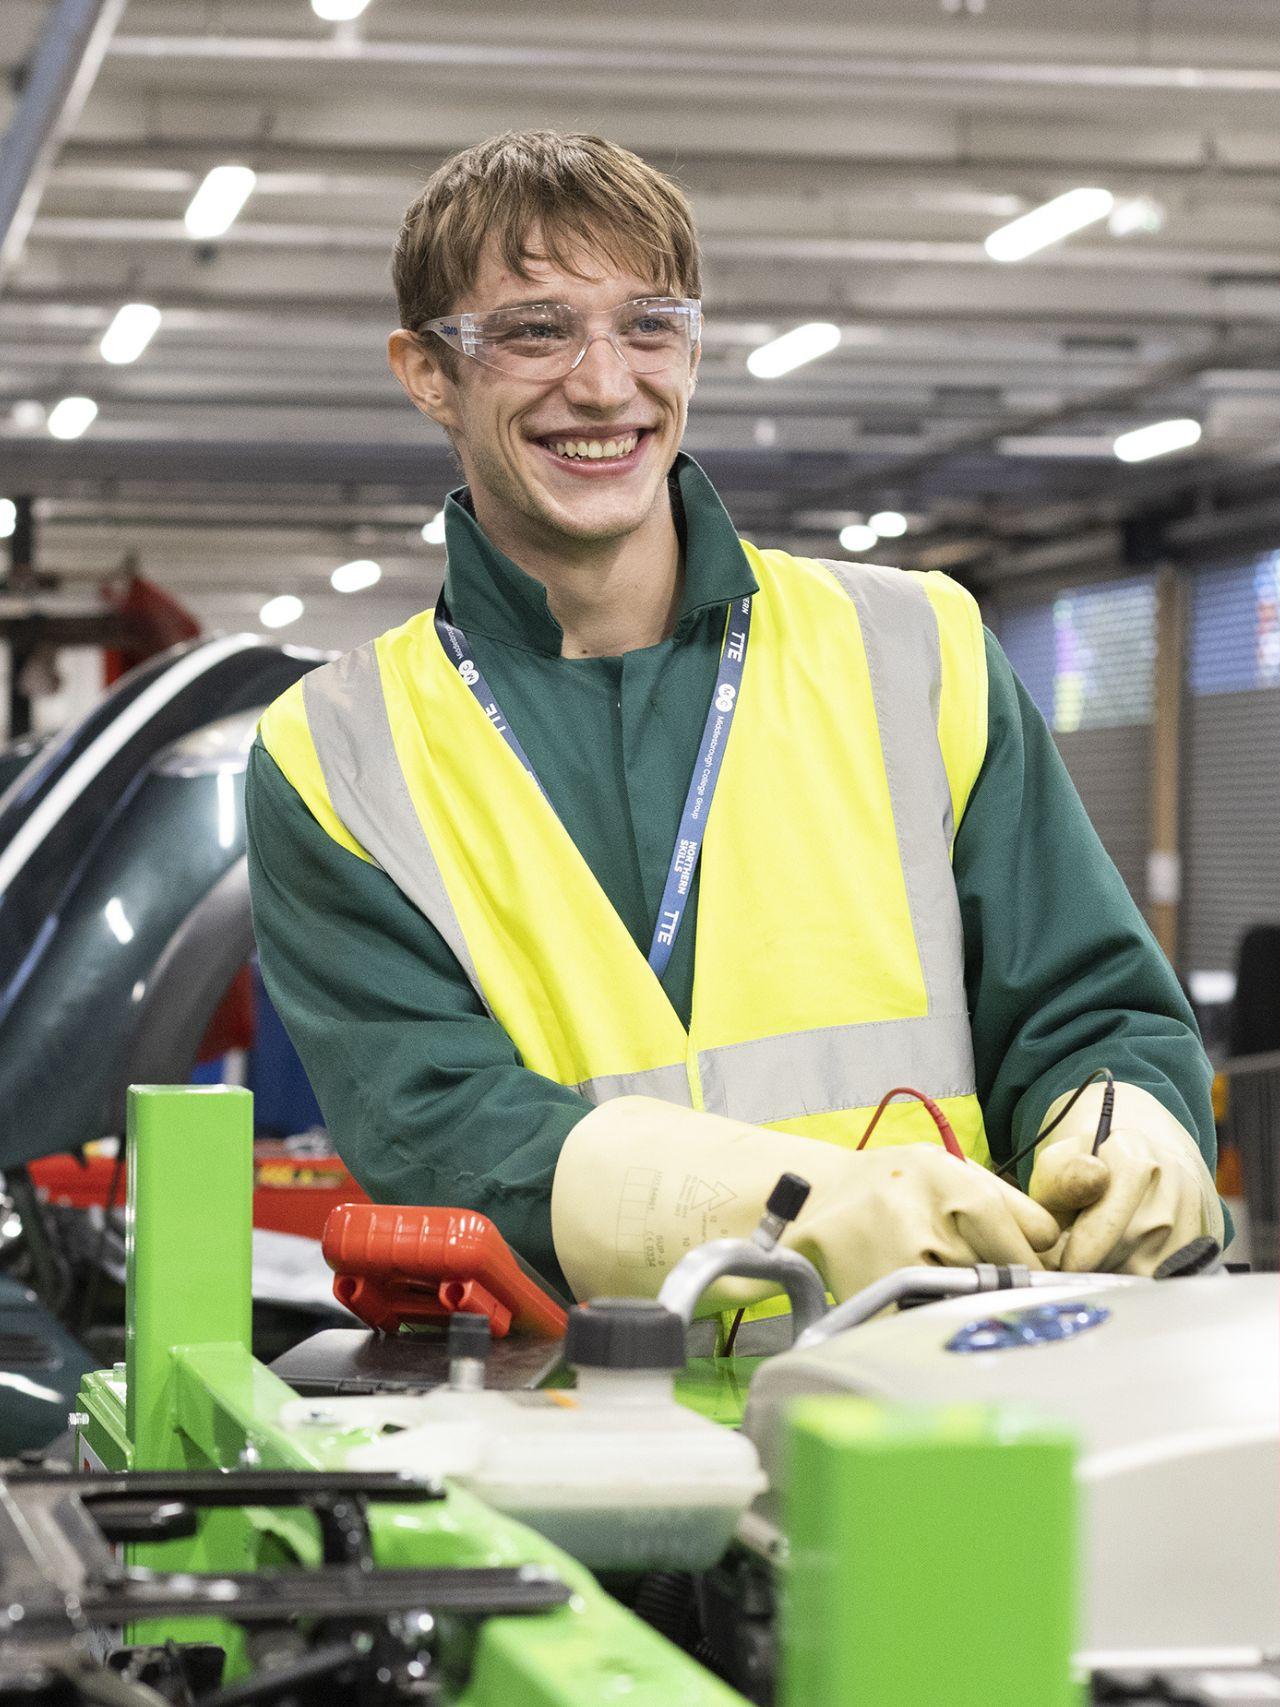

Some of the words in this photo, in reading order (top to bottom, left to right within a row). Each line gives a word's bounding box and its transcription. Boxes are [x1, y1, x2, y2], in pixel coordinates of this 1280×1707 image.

[727, 631, 746, 663] TTE
[704, 715, 724, 768] Middlesbrough
[697, 768, 711, 796] College
[691, 797, 703, 820] Group
[674, 839, 689, 873] SKILLS
[677, 840, 698, 895] NORTHERN
[657, 910, 680, 946] TTE
